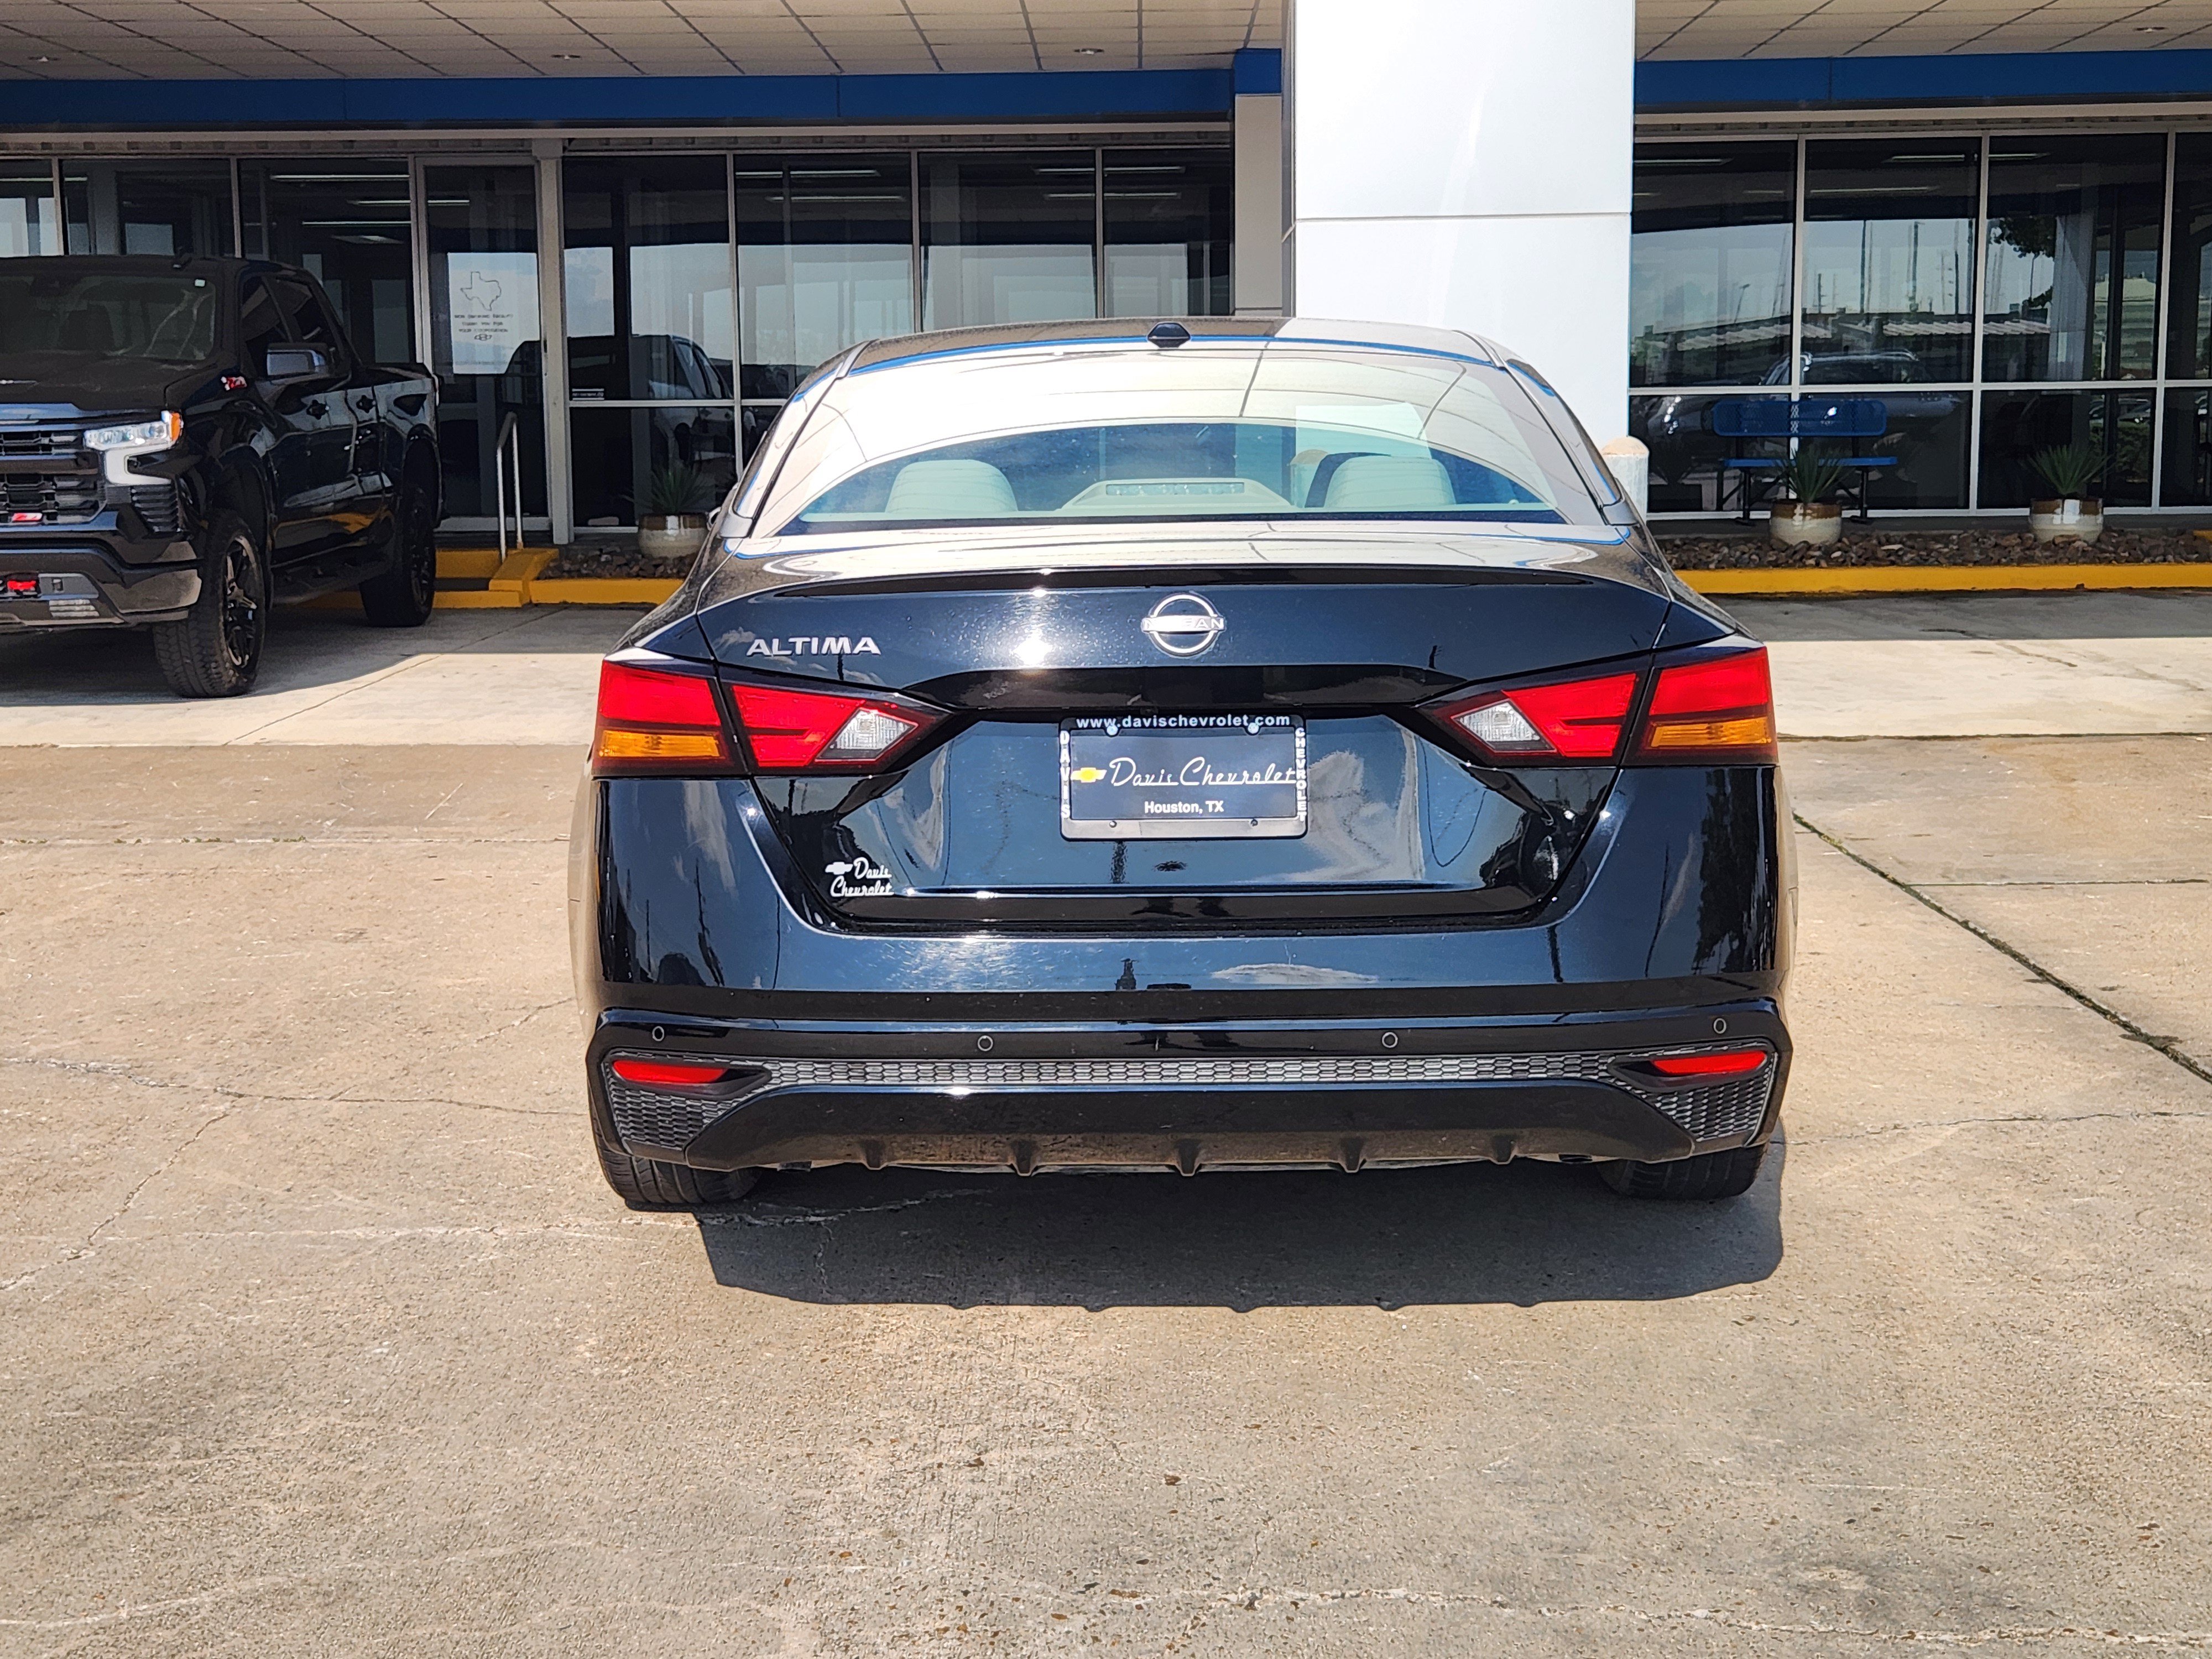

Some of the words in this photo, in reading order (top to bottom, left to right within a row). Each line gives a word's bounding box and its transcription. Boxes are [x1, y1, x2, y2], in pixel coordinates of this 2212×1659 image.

[747, 637, 881, 656] ALTIMA
[1076, 714, 1290, 728] www.davischevroletcom
[1060, 731, 1071, 818] DAVIS
[1109, 757, 1179, 786] Davis
[1180, 757, 1297, 786] Chevrolet
[1295, 727, 1307, 821] CHEVROLET
[1144, 801, 1203, 814] Houston,
[1206, 800, 1224, 812] TX
[853, 857, 892, 879] Davis
[830, 875, 894, 897] Chevrolet
